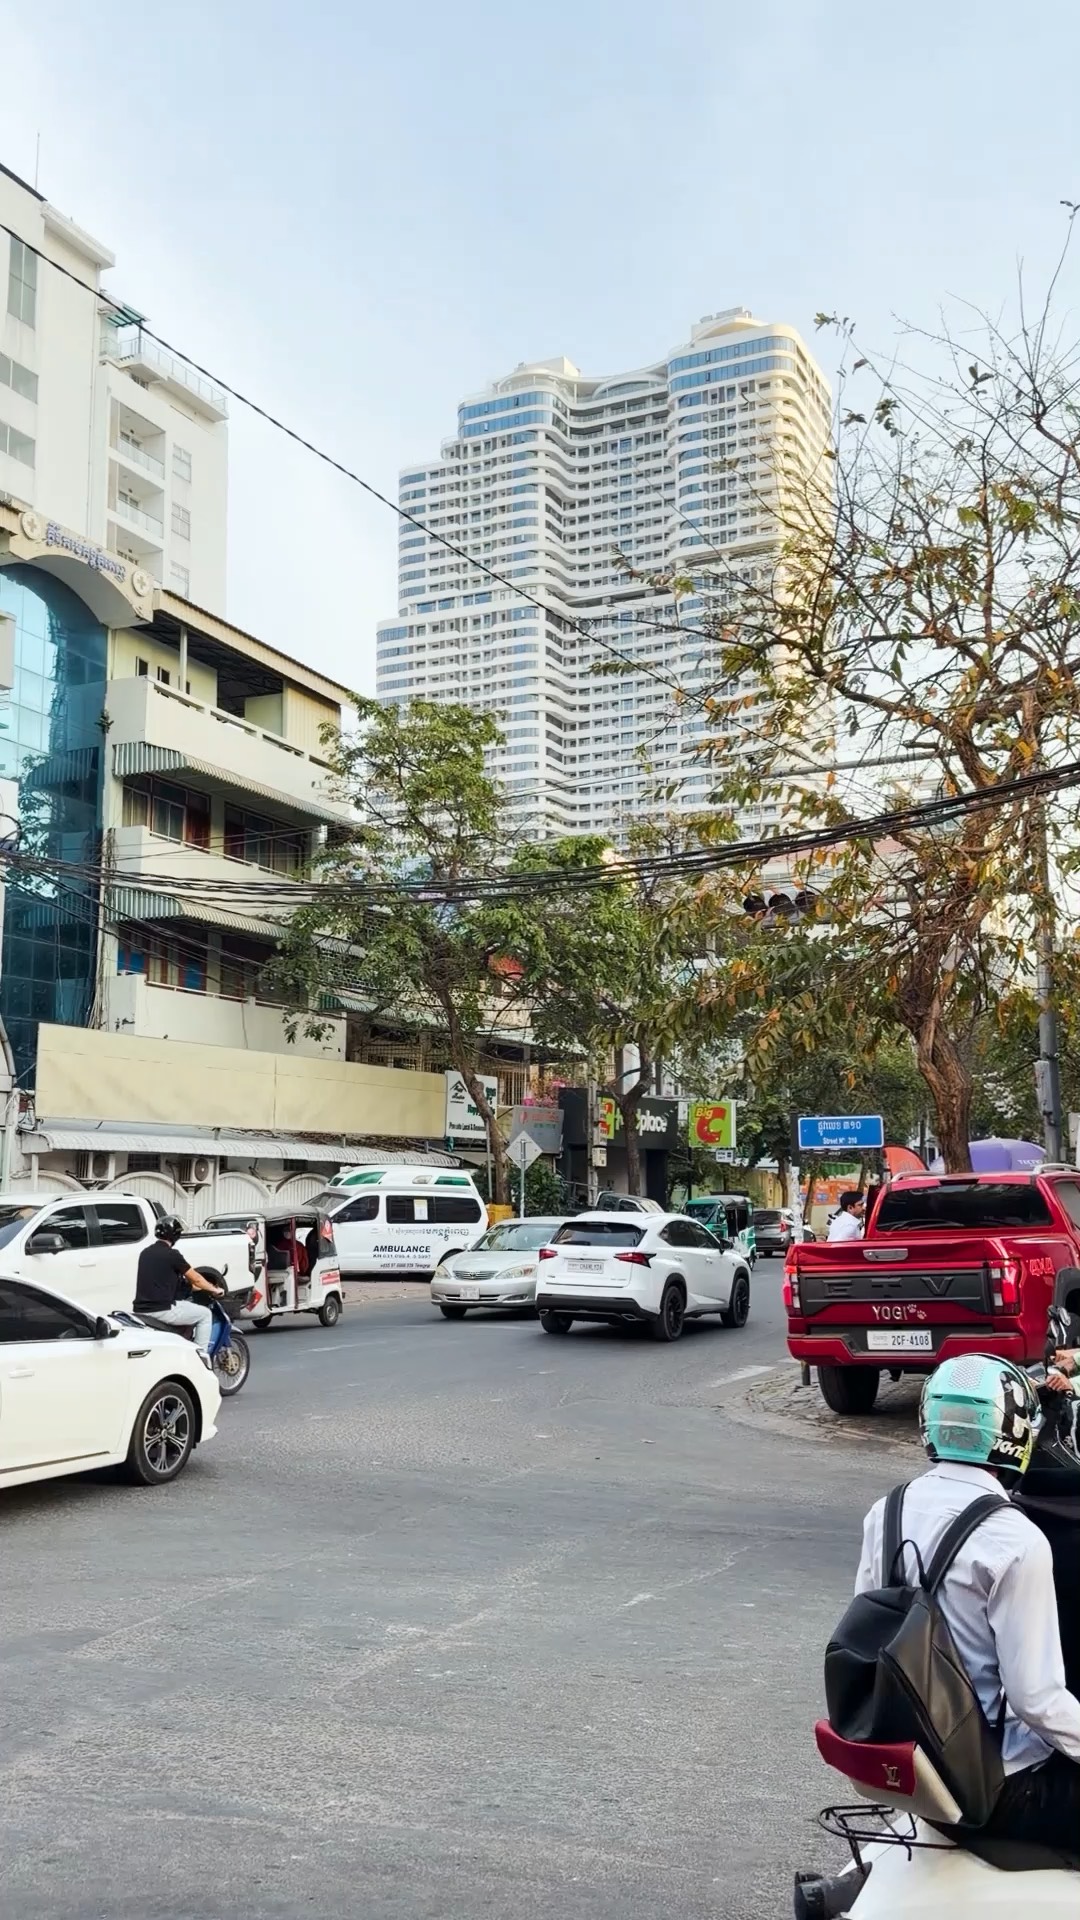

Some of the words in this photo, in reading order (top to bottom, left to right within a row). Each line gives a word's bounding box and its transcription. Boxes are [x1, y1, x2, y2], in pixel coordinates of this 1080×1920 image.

[696, 1107, 713, 1120] Big
[695, 1105, 727, 1144] C
[823, 1137, 838, 1145] Street
[373, 1245, 431, 1253] AMBULANCE
[872, 1305, 908, 1320] YOGI
[891, 1335, 930, 1346] 2CF-4108
